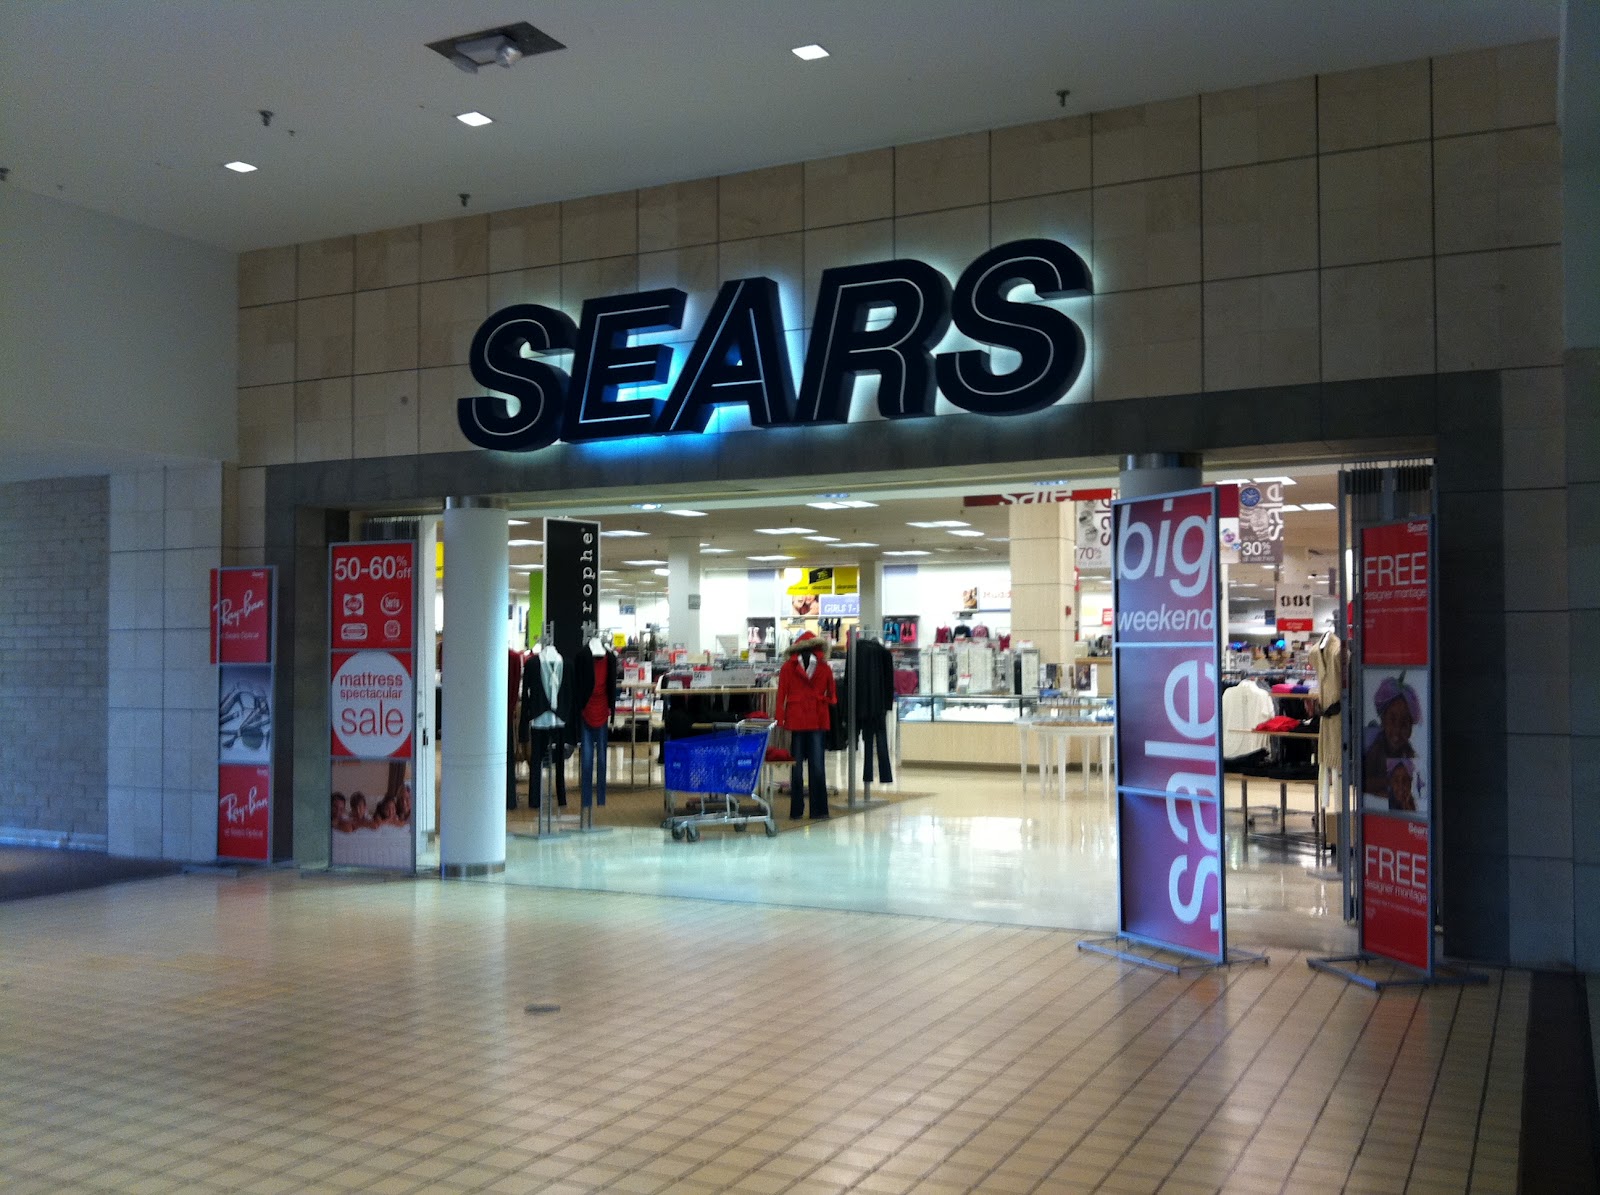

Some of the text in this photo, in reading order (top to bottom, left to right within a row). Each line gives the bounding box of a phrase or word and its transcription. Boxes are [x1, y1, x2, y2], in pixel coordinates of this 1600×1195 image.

[458, 238, 1093, 450] SEARS
[1117, 497, 1213, 598] big
[1364, 551, 1427, 588] FREE
[340, 672, 403, 687] mattress
[340, 687, 403, 702] spectacular
[341, 699, 404, 737] sale
[1365, 844, 1427, 889] FREE
